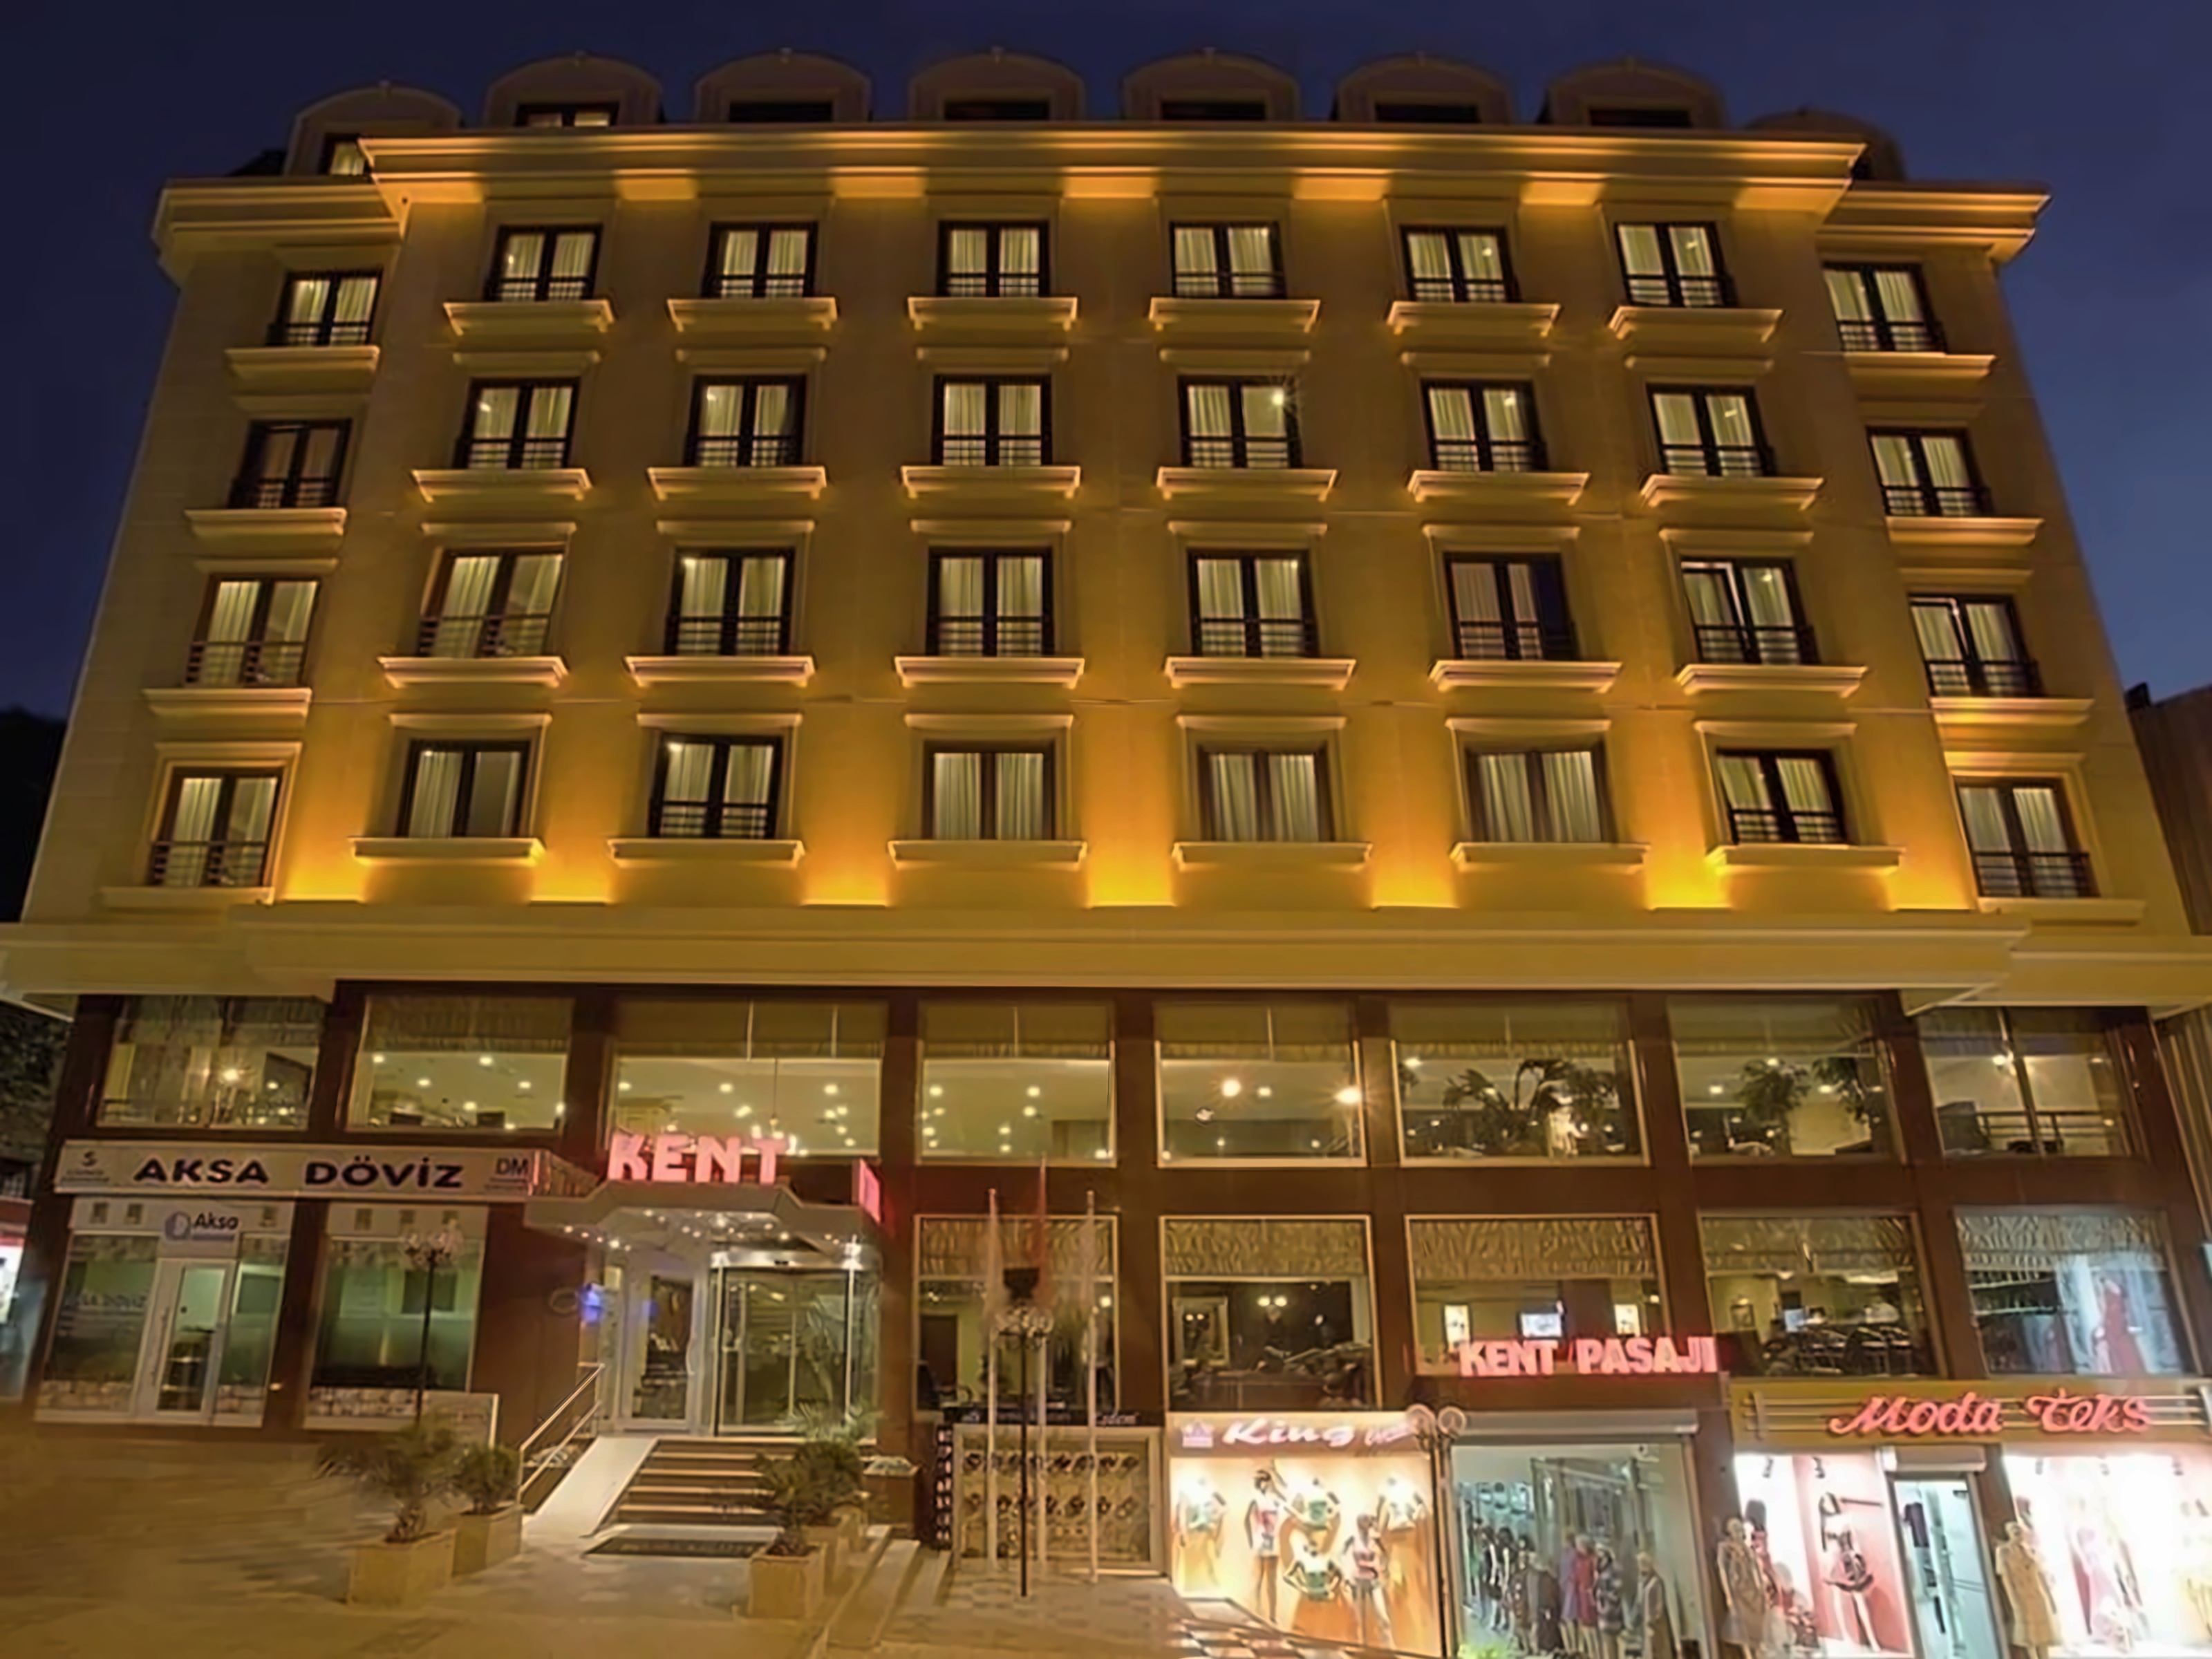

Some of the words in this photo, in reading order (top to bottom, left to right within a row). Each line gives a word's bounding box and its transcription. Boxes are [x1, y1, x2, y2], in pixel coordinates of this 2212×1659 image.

[133, 1158, 269, 1184] AKSA
[305, 1154, 463, 1188] DÖVİZ
[608, 1134, 785, 1184] KENT
[1459, 1340, 1558, 1376] KENT
[1828, 1392, 2003, 1434] Moda
[1222, 1416, 1355, 1447] King
